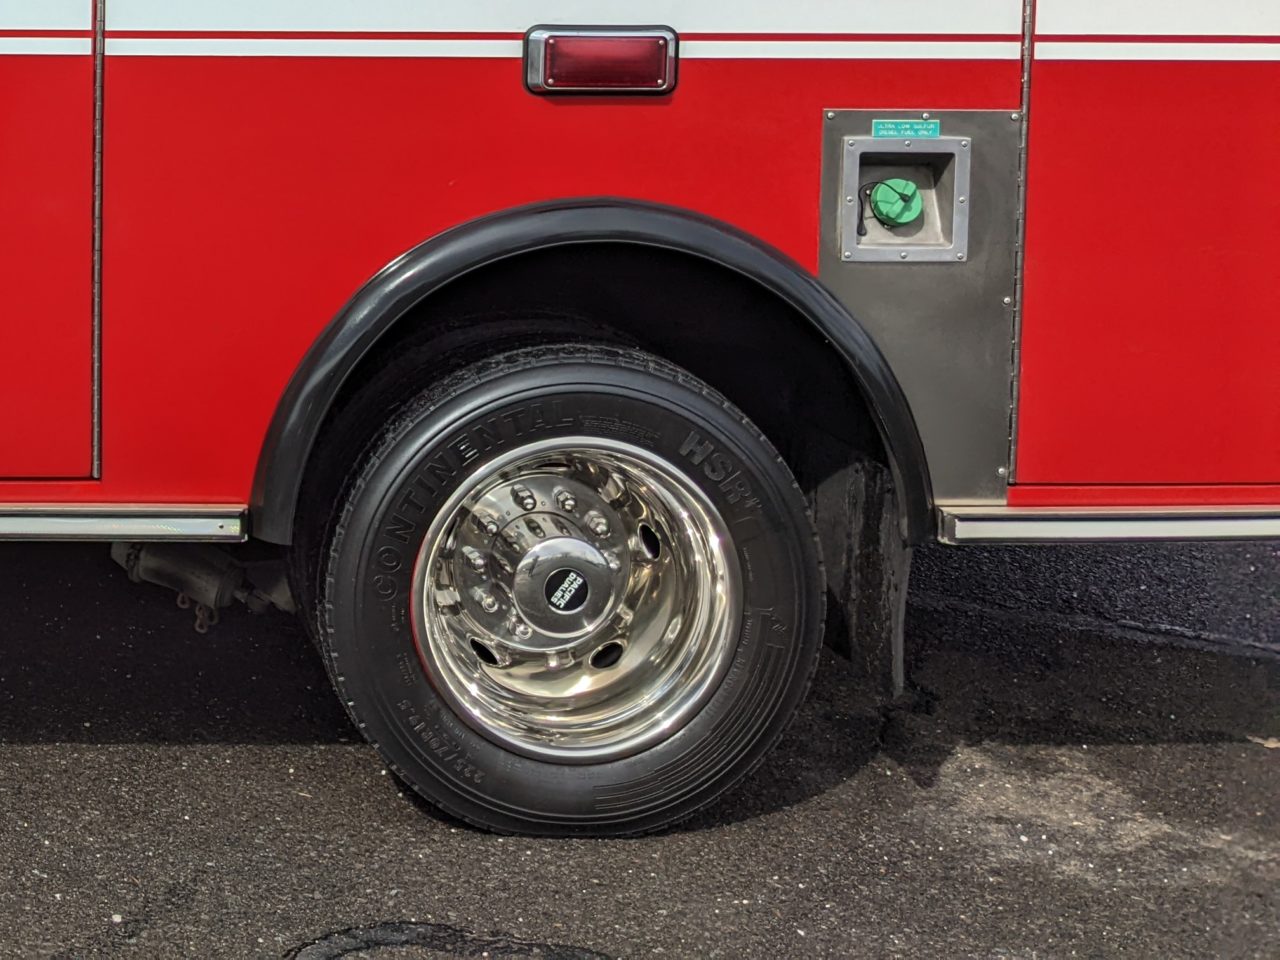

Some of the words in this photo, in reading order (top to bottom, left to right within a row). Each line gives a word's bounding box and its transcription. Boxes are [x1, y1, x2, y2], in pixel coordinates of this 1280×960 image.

[373, 399, 577, 602] CONTINENTAL
[550, 571, 577, 604] DUALIES
[555, 576, 584, 609] PACIFIC
